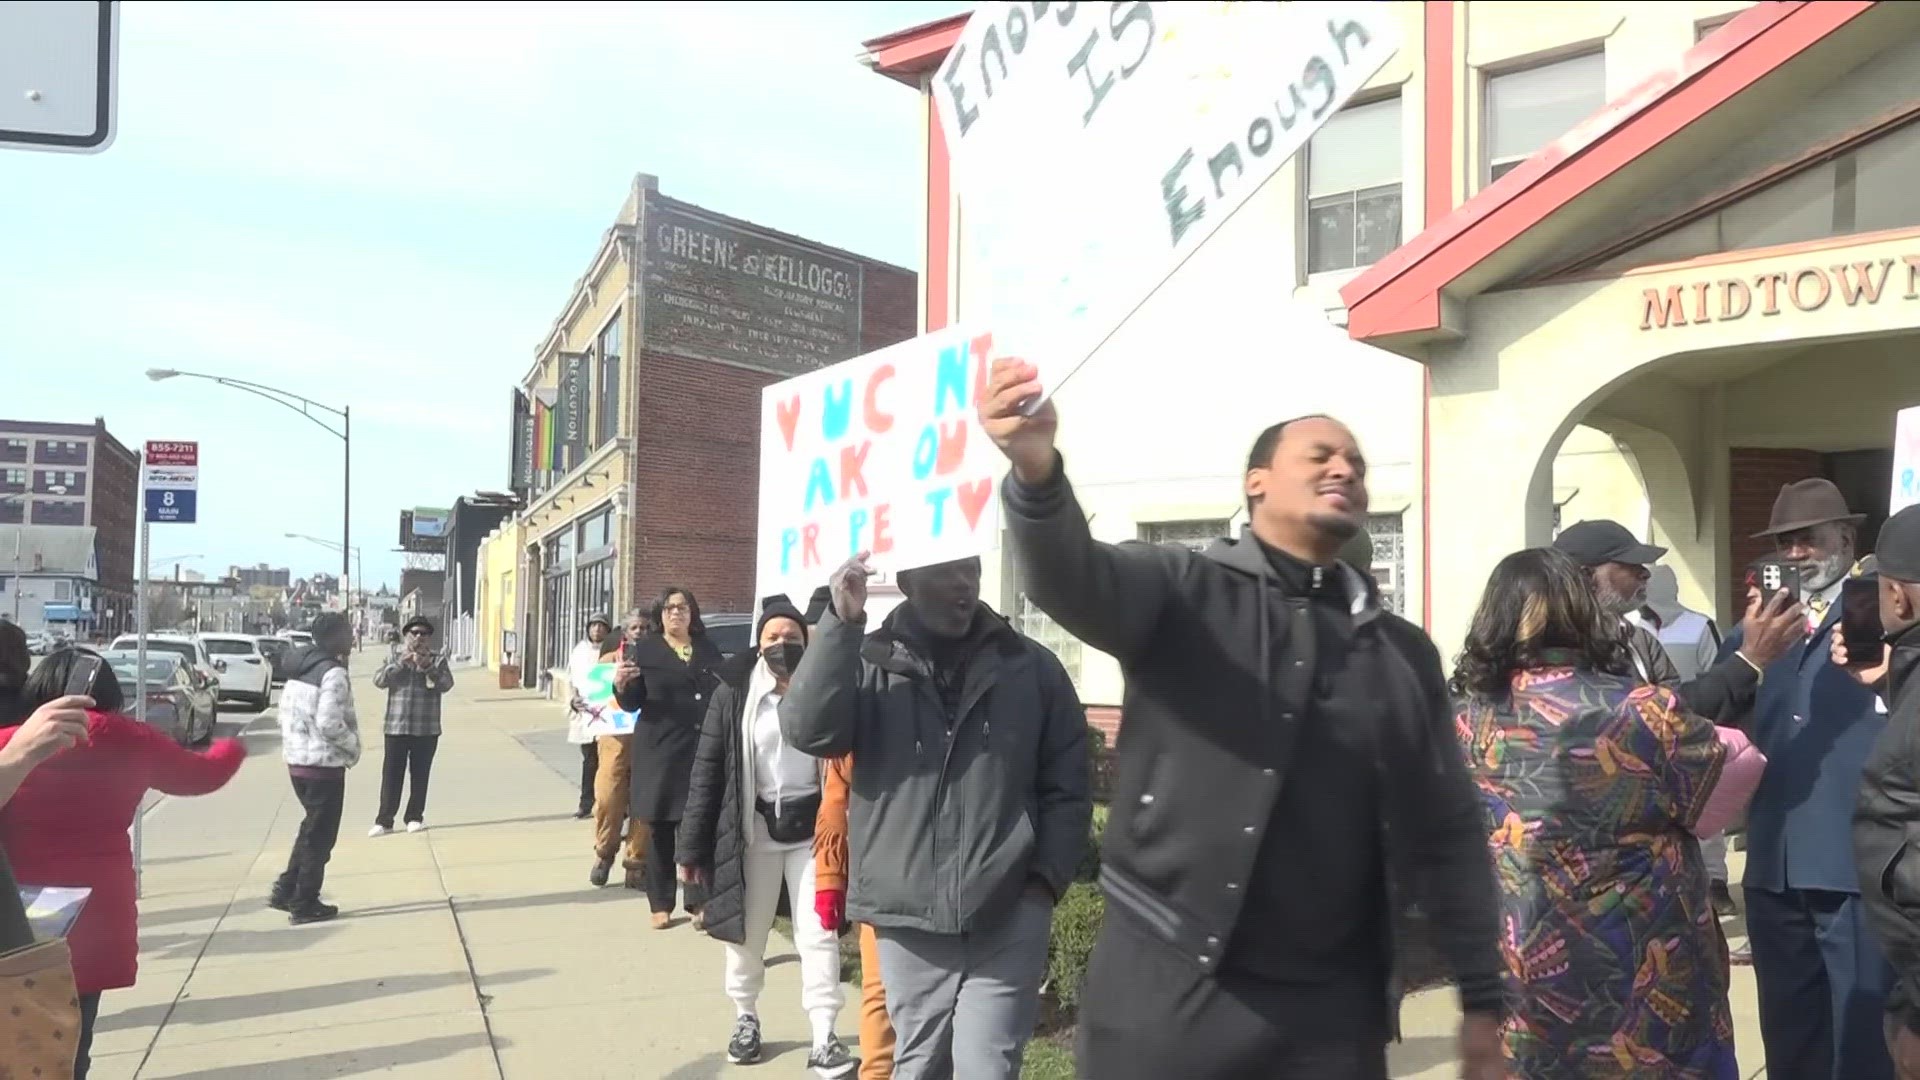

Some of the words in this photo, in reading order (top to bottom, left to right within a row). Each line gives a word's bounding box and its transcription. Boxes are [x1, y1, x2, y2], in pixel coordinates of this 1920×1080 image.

[943, 2, 1077, 138] Eno
[1160, 17, 1371, 249] Enough
[657, 223, 739, 272] GREENE
[567, 357, 580, 441] REVOLUTION
[162, 491, 175, 506] 8
